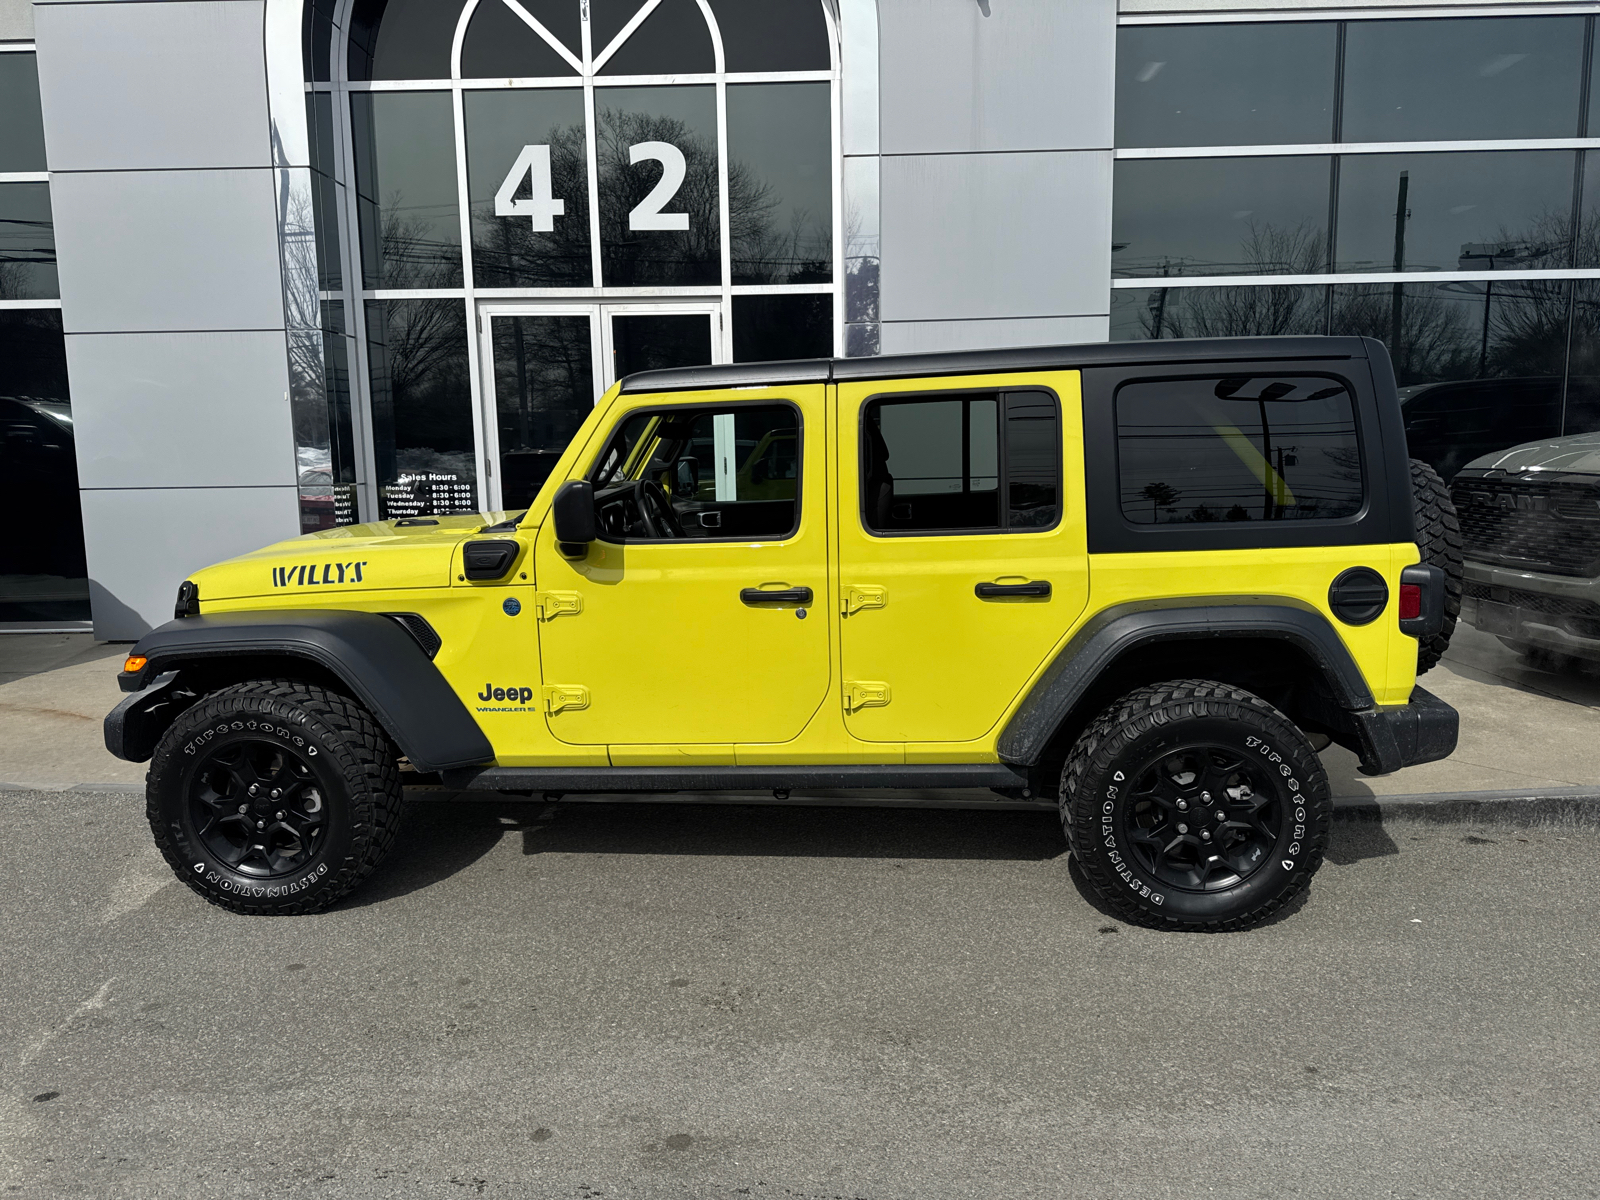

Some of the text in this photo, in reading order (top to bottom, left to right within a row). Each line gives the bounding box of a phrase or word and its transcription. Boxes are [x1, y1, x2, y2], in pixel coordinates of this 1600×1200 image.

[401, 473, 457, 481] Sales Hours
[1469, 490, 1549, 511] RAM
[272, 561, 367, 587] WILLYS
[478, 683, 533, 704] Jeep
[184, 721, 305, 755] Firestone
[1245, 735, 1306, 855] Firestone
[1102, 785, 1164, 906] DESTINATION
[206, 862, 328, 898] DESTINATION
